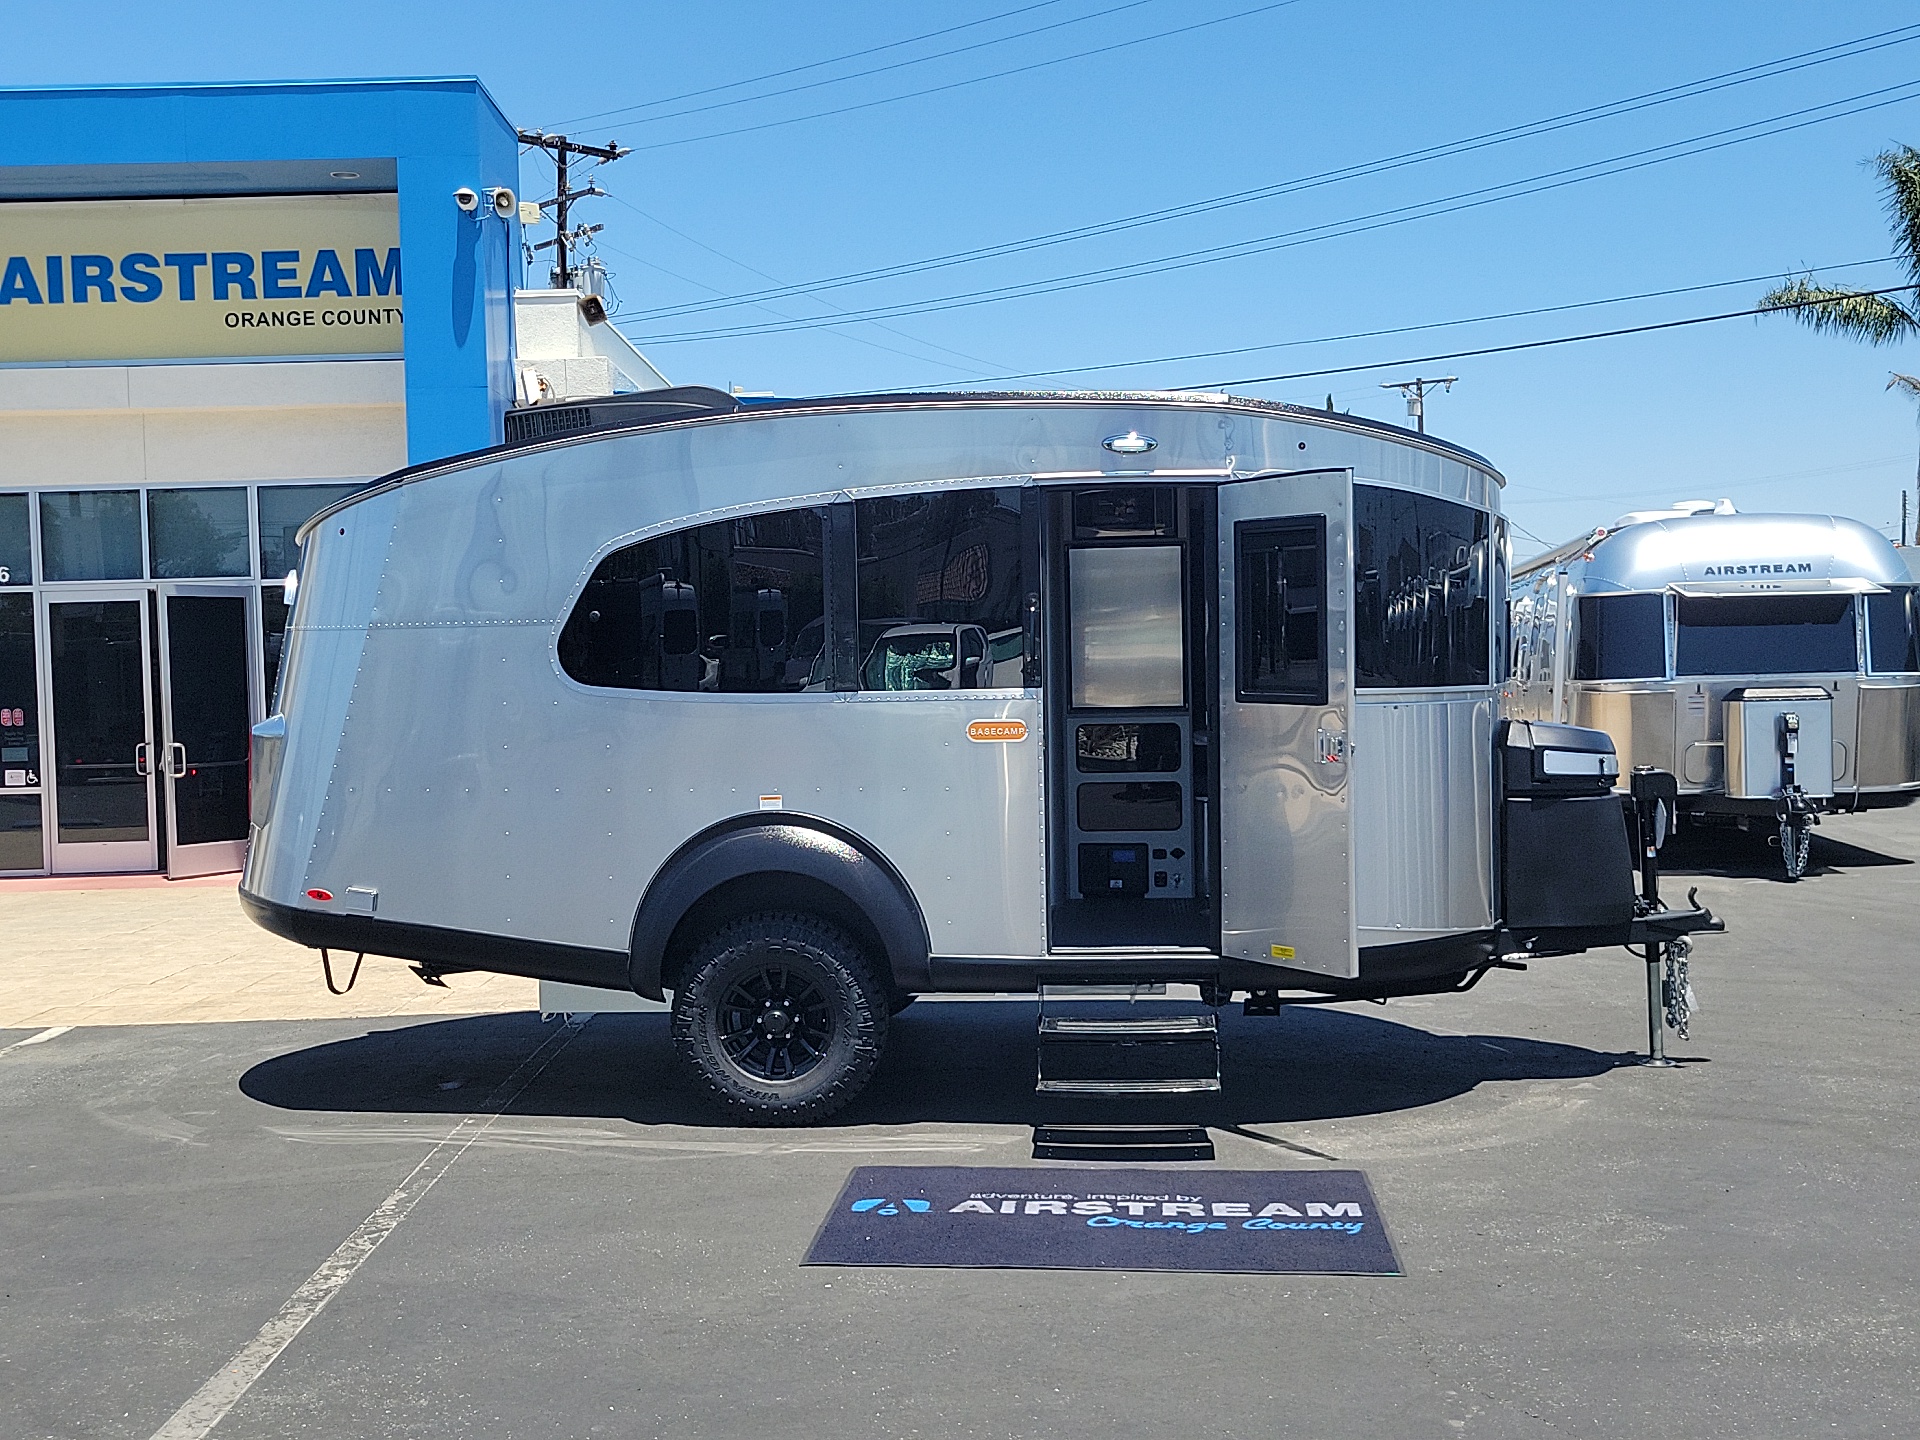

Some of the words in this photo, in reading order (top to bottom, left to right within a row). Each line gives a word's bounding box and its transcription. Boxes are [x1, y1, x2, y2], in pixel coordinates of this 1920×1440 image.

[0, 247, 402, 305] AIRSTREAM
[225, 310, 315, 328] ORANGE
[1704, 563, 1812, 576] AIRSTREAM
[970, 727, 1025, 736] BASECAMP
[1086, 1193, 1169, 1201] inspired
[1176, 1194, 1203, 1203] by
[949, 1200, 1363, 1217] AIRSTREAM
[1086, 1215, 1228, 1234] Orange
[1241, 1217, 1366, 1235] County
